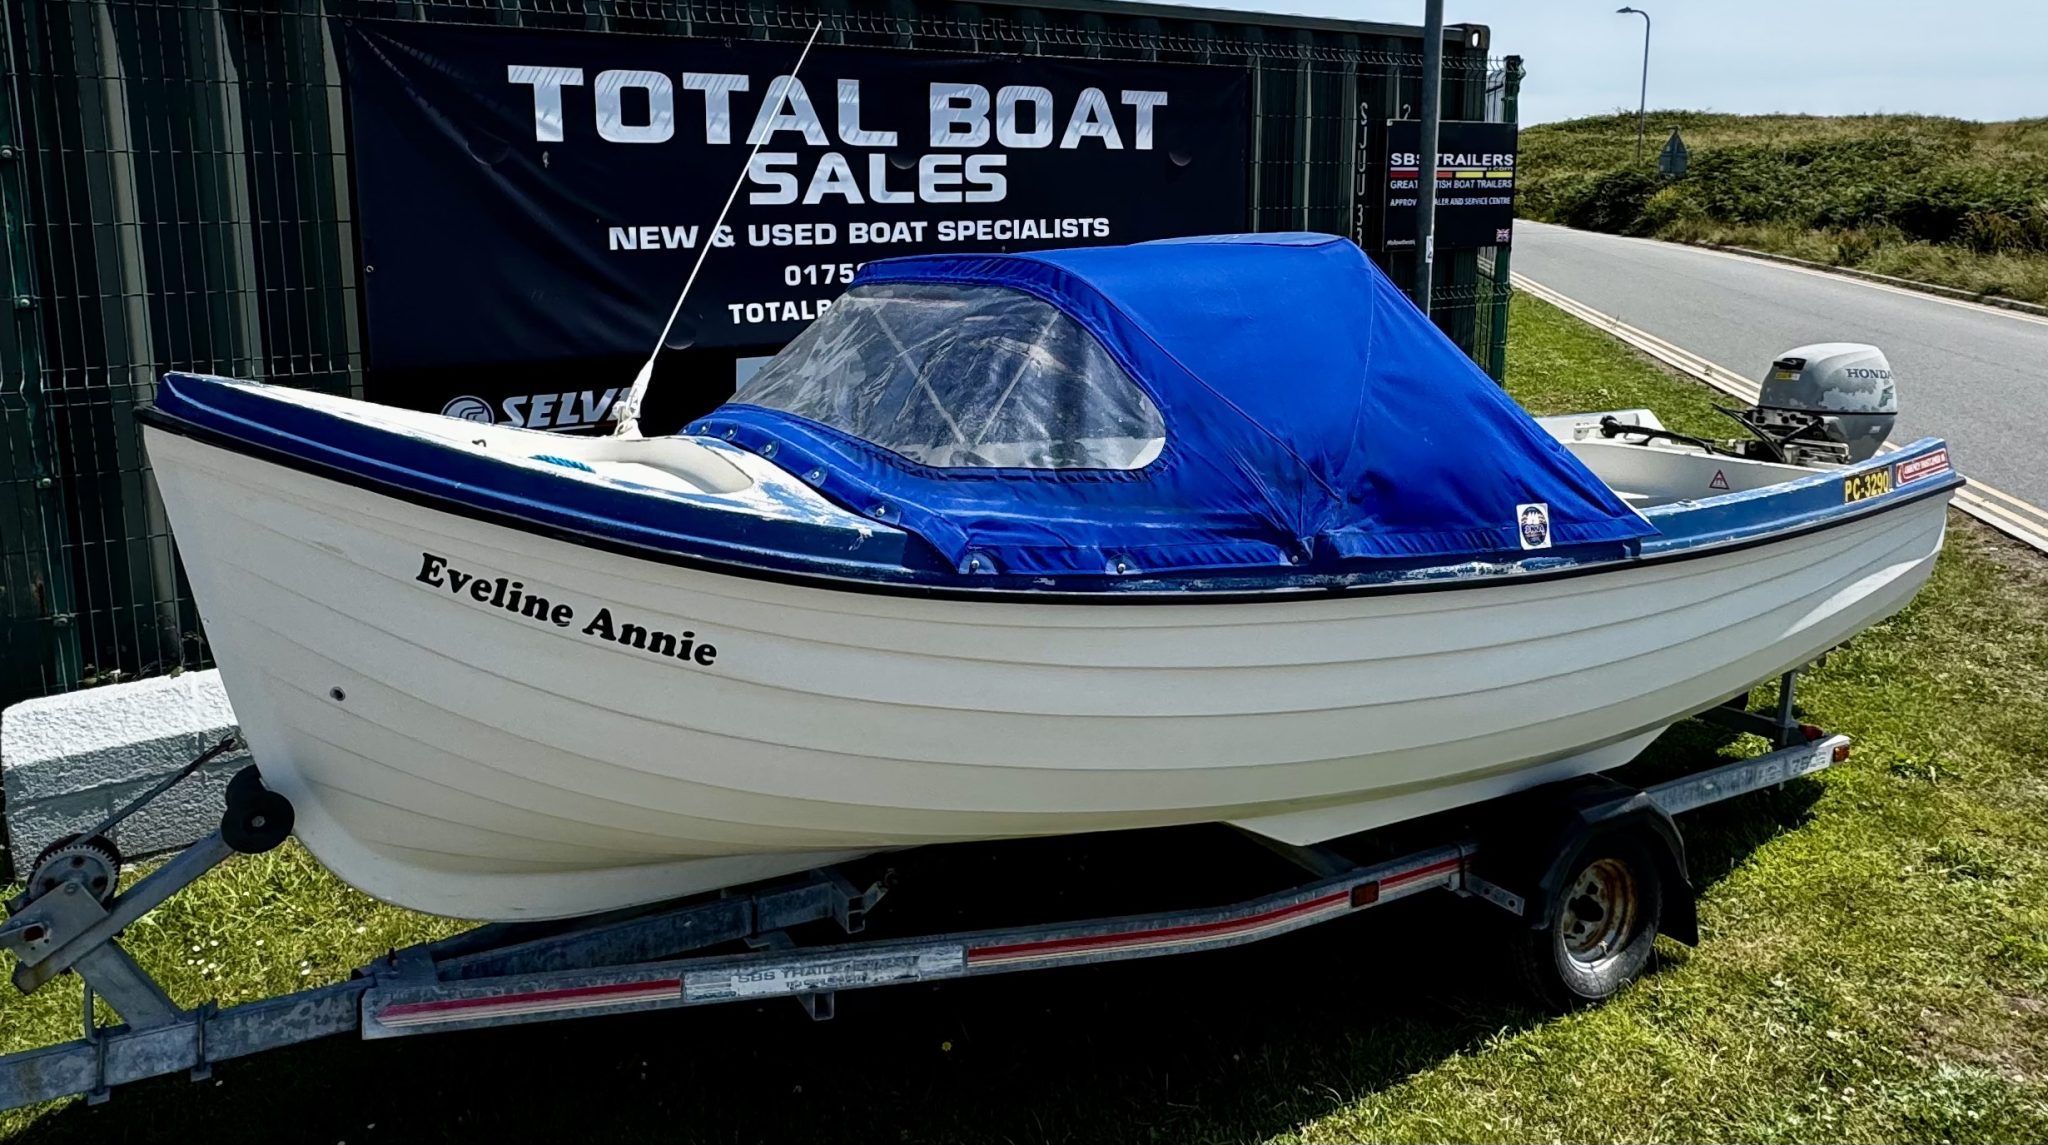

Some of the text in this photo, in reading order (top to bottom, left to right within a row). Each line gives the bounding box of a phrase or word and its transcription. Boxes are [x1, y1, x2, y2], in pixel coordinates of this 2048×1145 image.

[507, 65, 1168, 150] TOTAL BOAT
[1390, 152, 1514, 166] SB TRAILERS
[748, 152, 1008, 205] SALES
[1453, 179, 1475, 189] BOAT
[1477, 179, 1512, 189] TRAILERS
[1390, 198, 1418, 207] APPROV
[609, 218, 1110, 250] NEW & USED BOAT SPECIALISTS
[784, 263, 866, 286] 0175
[1844, 470, 1889, 502] PC-3290
[416, 552, 718, 666] Eveline Annie
[738, 970, 776, 984] SBS
